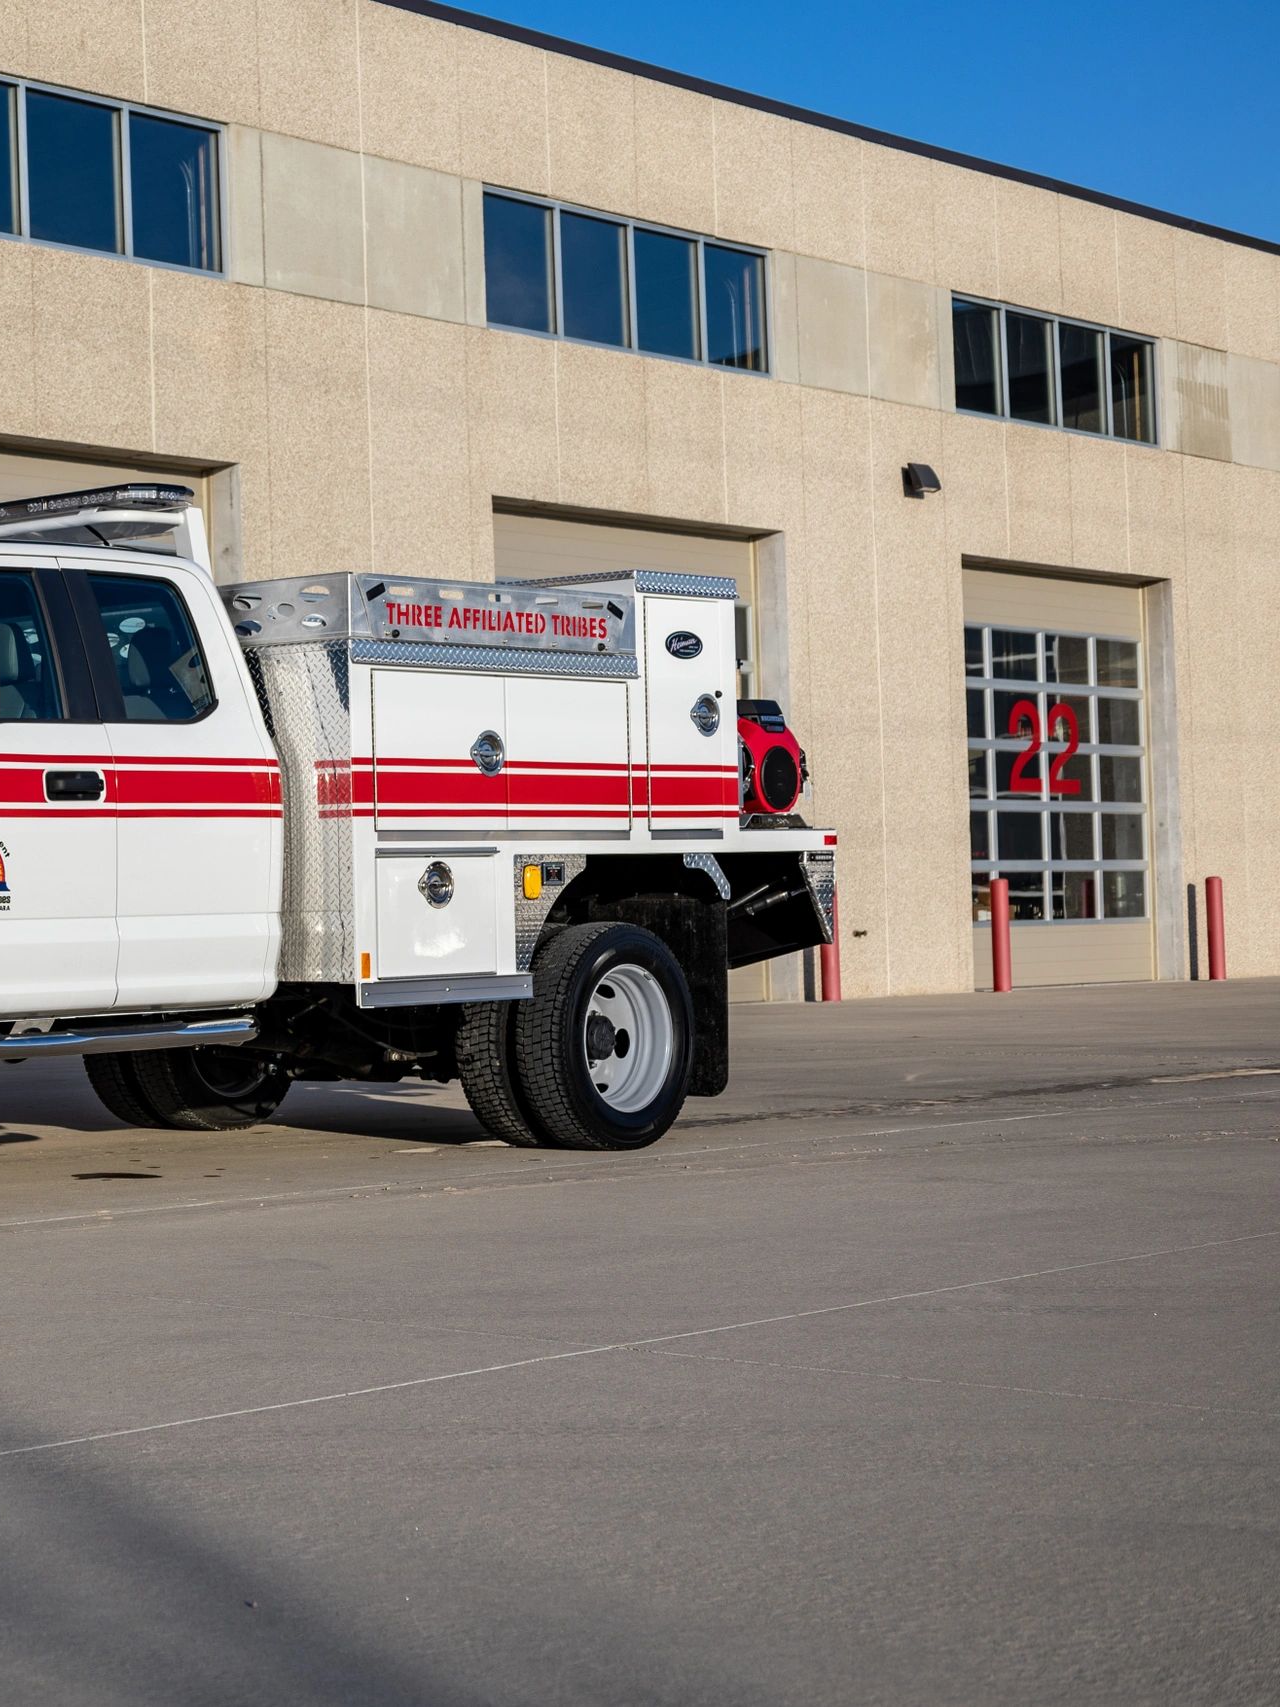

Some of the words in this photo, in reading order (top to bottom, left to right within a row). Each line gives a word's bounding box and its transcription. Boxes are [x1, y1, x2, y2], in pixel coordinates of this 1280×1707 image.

[385, 602, 443, 628] THREE
[448, 607, 546, 634] AFFILIATED
[551, 614, 608, 639] TRIBES
[1008, 700, 1081, 794] 22
